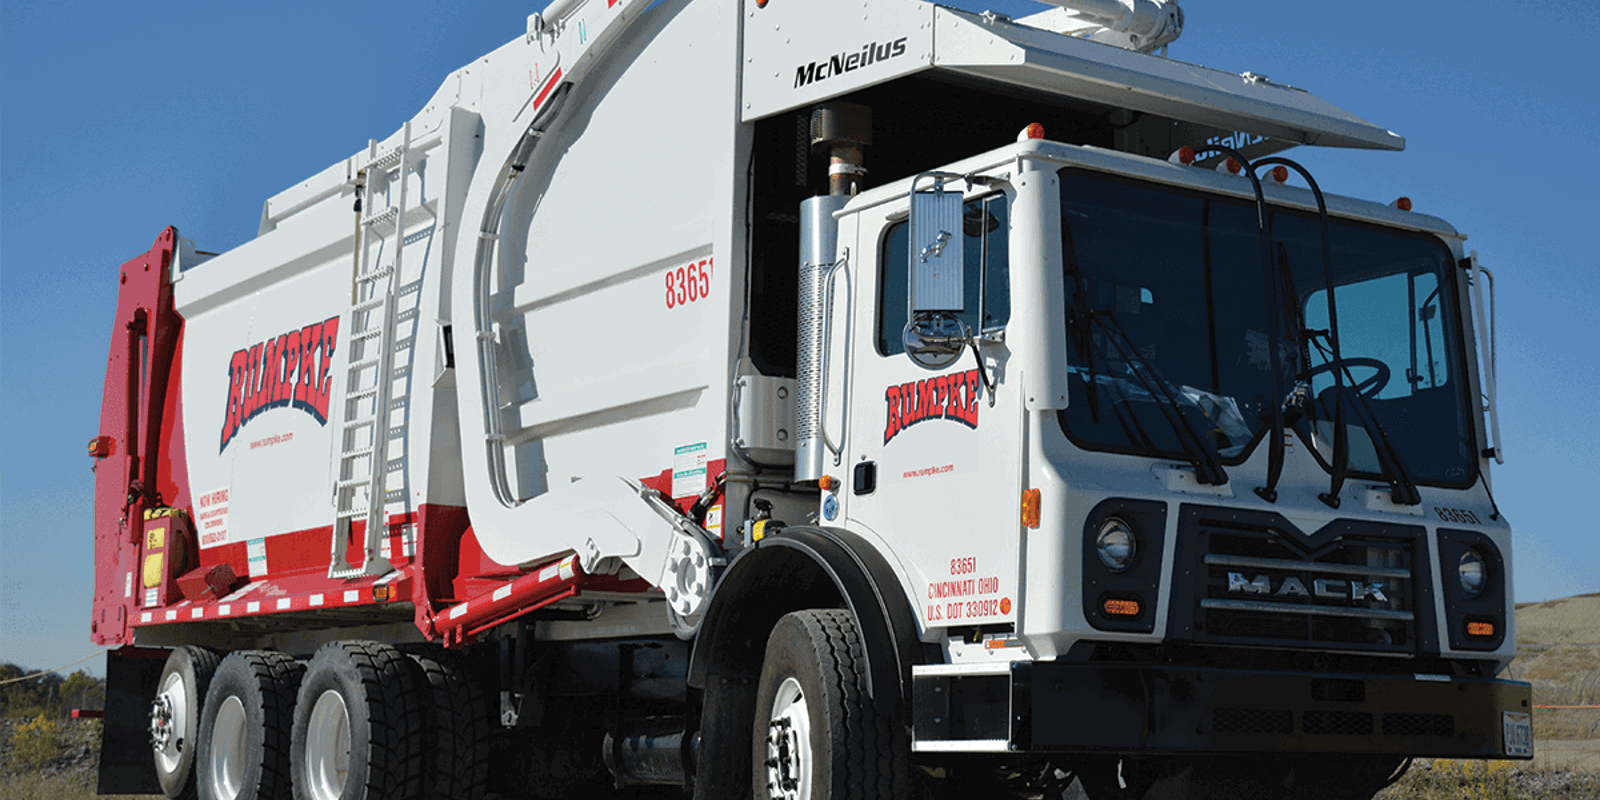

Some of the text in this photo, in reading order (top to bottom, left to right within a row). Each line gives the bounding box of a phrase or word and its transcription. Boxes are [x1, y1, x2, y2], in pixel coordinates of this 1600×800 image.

[793, 37, 907, 89] McNeilus
[219, 315, 340, 456] RUMPKE
[883, 370, 979, 446] RUMPKE
[903, 464, 954, 479] www.rumpke.com
[1434, 506, 1481, 525] 83651
[950, 556, 976, 575] 83651
[928, 576, 999, 600] CINCINNATI OHIO
[1228, 571, 1388, 602] MACK
[928, 599, 998, 621] U.S. DOT 330912
